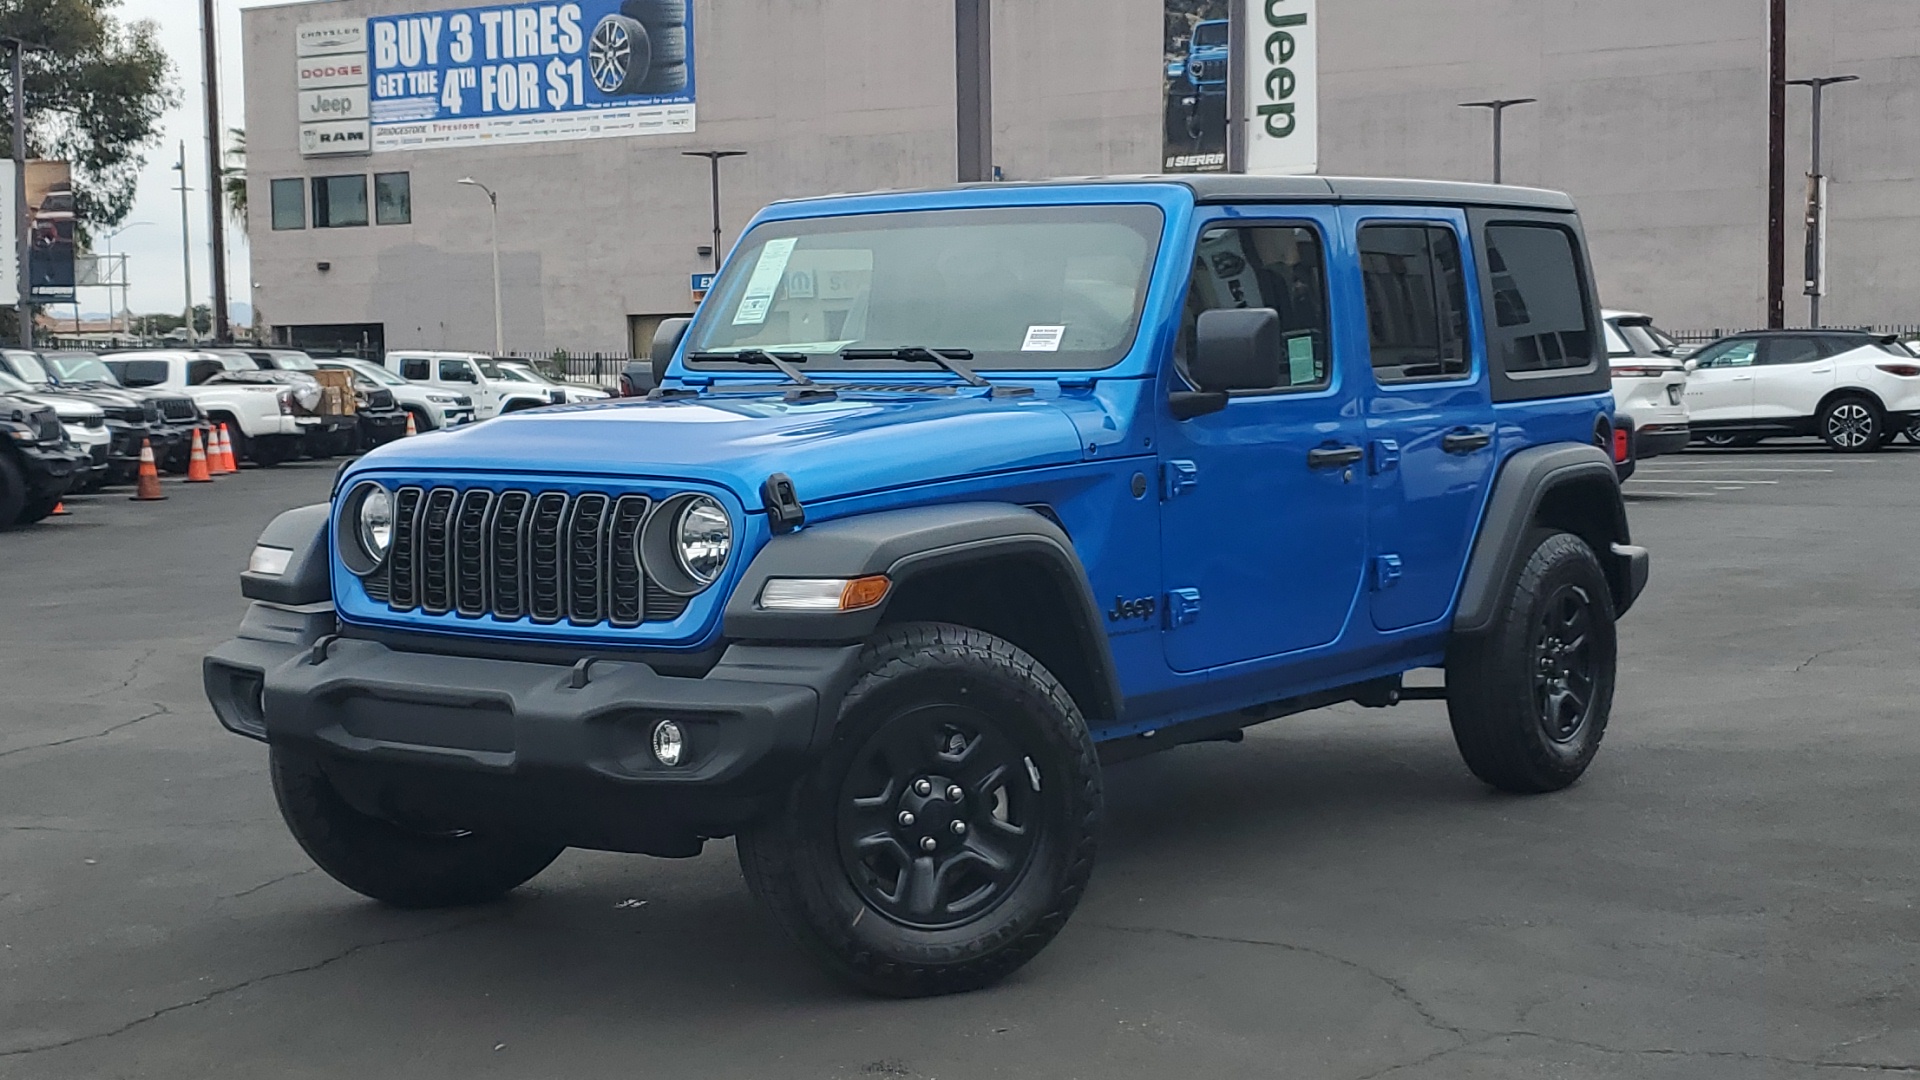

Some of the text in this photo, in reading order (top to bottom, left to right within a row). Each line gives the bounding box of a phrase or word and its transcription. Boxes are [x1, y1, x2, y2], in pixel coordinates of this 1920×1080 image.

[301, 28, 360, 39] CHRYSLER
[373, 3, 583, 69] BUY 3 TIRES
[301, 65, 362, 79] DODGE
[1256, 0, 1308, 139] Jeep
[376, 73, 405, 98] GET
[407, 70, 438, 95] THE
[481, 62, 540, 112] FOR
[546, 56, 584, 111] $1
[310, 94, 352, 116] Jeep
[432, 122, 480, 133] Firestone
[320, 131, 364, 143] RAM
[1174, 152, 1226, 167] SIERRA
[1107, 594, 1155, 622] Jeep
